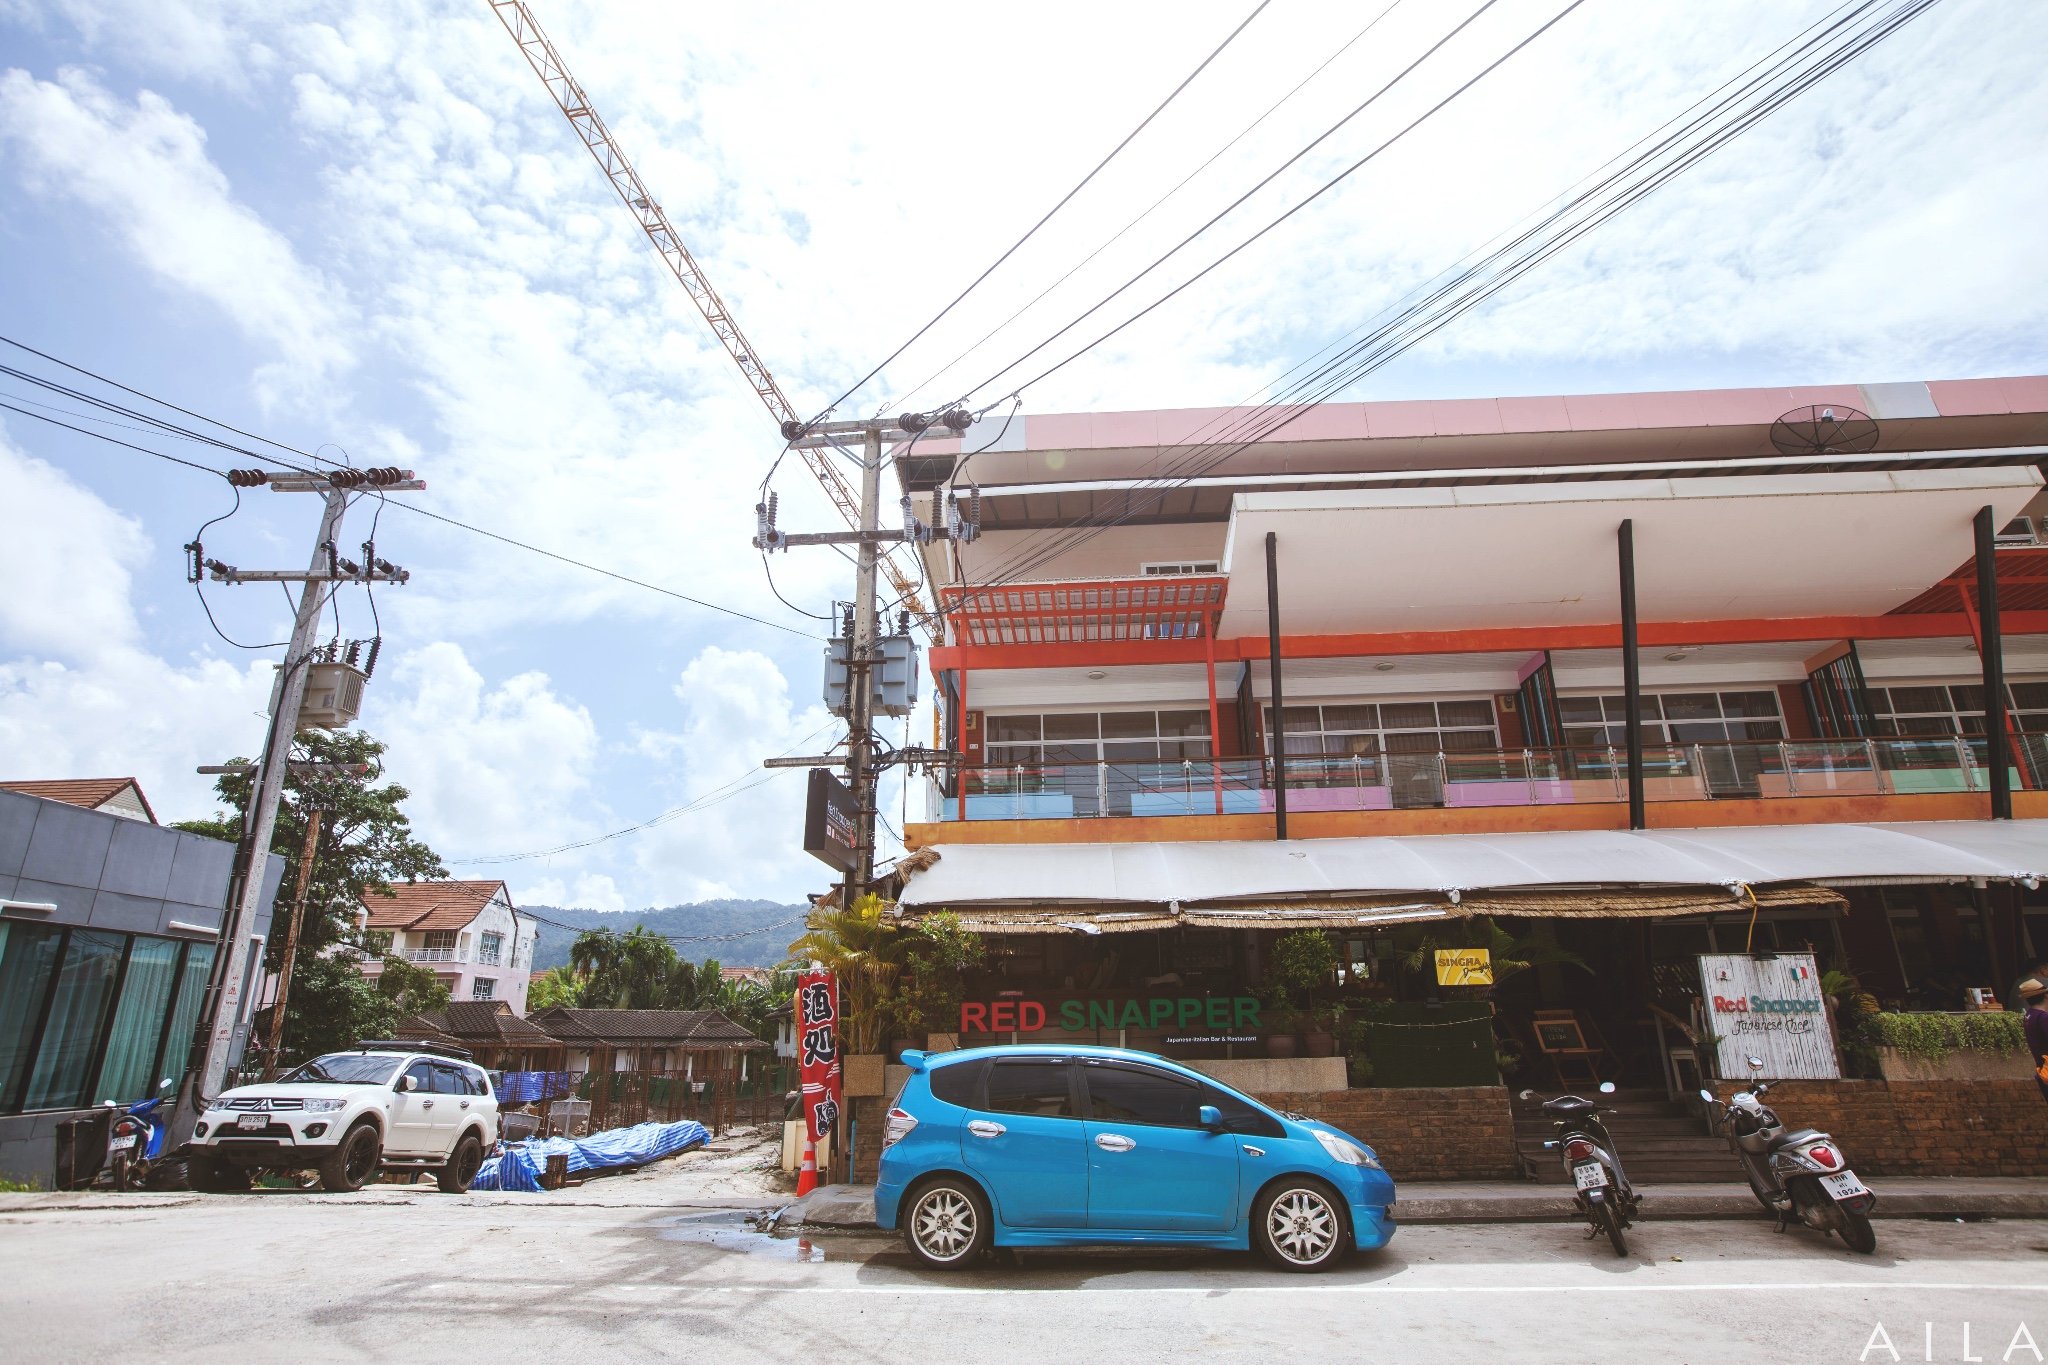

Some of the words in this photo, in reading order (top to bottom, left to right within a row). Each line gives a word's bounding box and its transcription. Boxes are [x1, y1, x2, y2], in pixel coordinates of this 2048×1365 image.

[1437, 957, 1481, 967] SINGHA
[960, 1001, 1046, 1033] RED
[1060, 996, 1263, 1031] SNAPPER
[1714, 995, 1748, 1013] Red
[1750, 995, 1821, 1017] Snapper
[802, 982, 836, 1067] 酒処
[1732, 1020, 1782, 1035] Japanese
[1785, 1018, 1811, 1034] Chef
[1836, 1186, 1861, 1197] 1924
